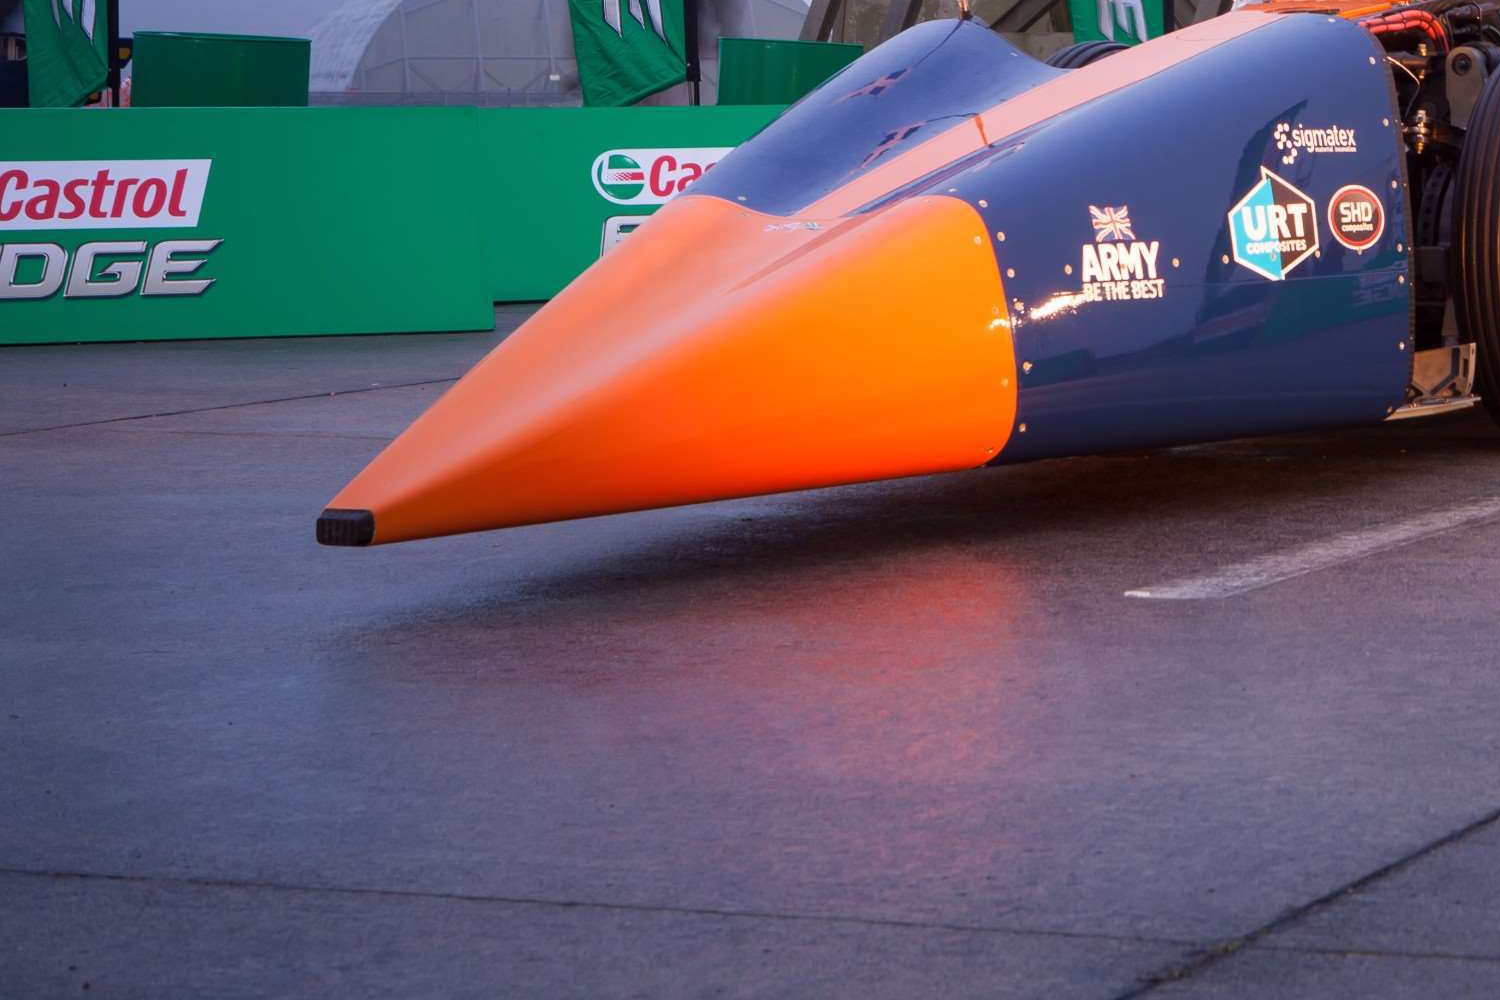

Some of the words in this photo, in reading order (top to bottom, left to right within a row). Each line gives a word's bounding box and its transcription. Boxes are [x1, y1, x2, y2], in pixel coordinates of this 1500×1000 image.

[1292, 124, 1357, 153] sigmatex
[0, 168, 188, 222] Castrol
[1242, 203, 1308, 241] URT
[1339, 202, 1372, 223] SHD
[1342, 223, 1374, 234] composites
[1082, 240, 1160, 282] ARMY
[1246, 239, 1308, 256] COMPOSITES
[0, 238, 224, 299] DGE
[1083, 282, 1103, 302] BE
[1102, 280, 1131, 300] THE
[1130, 278, 1165, 299] BEST
